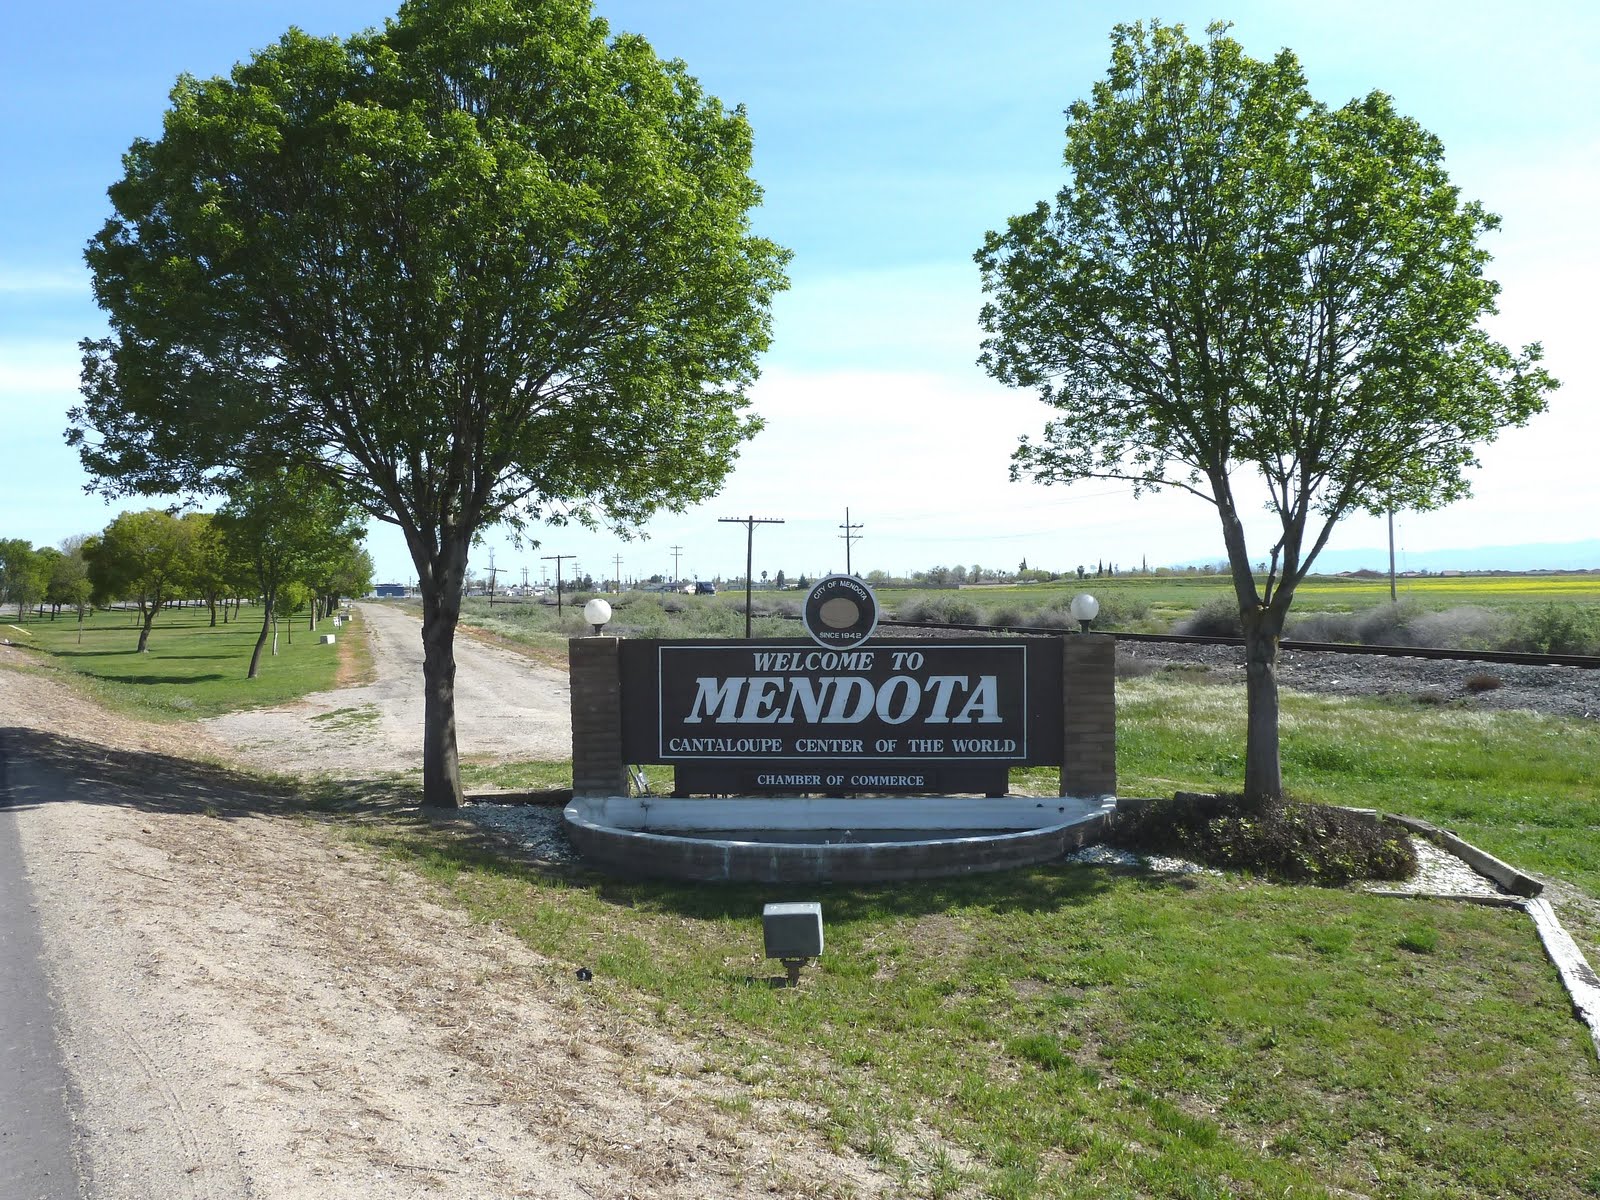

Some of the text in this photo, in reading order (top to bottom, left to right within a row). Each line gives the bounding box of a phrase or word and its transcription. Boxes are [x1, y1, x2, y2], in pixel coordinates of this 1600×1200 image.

[813, 580, 868, 601] CITY OF MENDOTA
[819, 631, 840, 639] SINCE
[752, 651, 925, 672] WELCOME TO
[683, 675, 1003, 726] MENDOTA
[669, 738, 1017, 754] CANTALOUPE CENTER OF THE WORLD
[757, 774, 925, 787] CHAMBER OF COMMERCE
